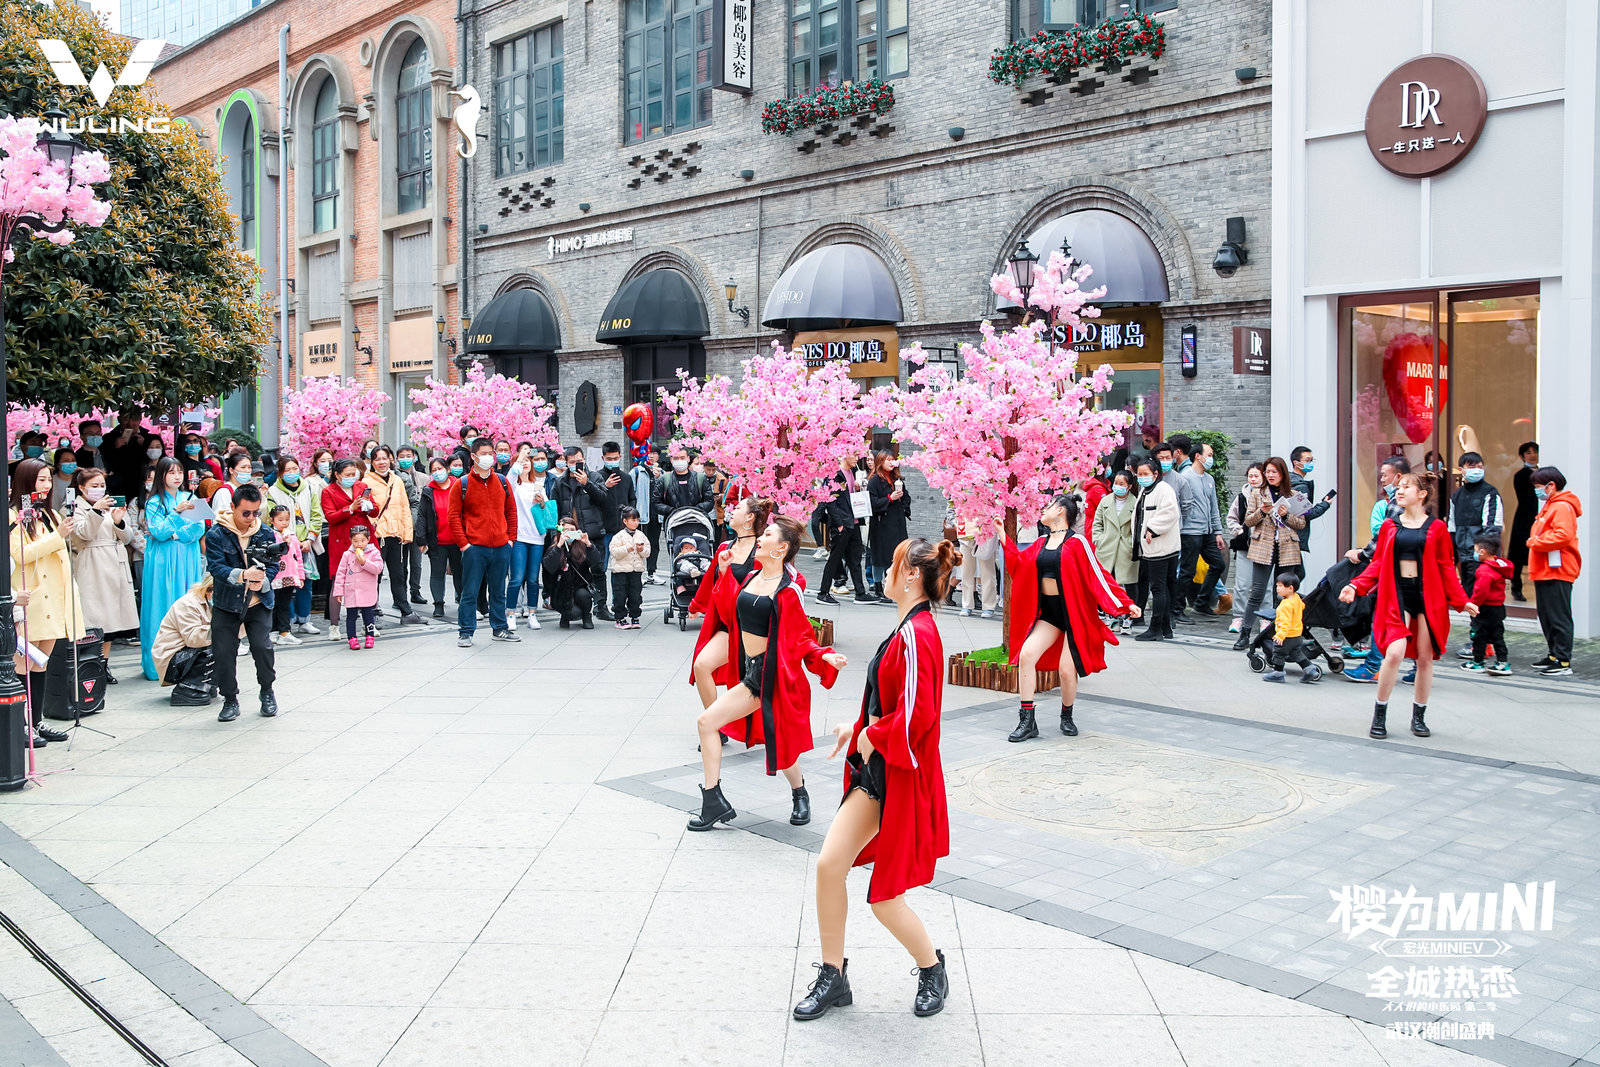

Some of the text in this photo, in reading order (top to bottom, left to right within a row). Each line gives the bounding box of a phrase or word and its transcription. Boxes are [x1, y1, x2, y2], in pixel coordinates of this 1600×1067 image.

[732, 3, 747, 79] 椰岛美容
[1398, 81, 1444, 129] DR
[1378, 131, 1465, 154] 一生只送一人
[555, 236, 582, 254] HIMO
[1100, 321, 1145, 350] 椰岛
[849, 340, 882, 363] 椰岛
[1074, 344, 1096, 352] ONAL
[1406, 362, 1448, 380] MARR M
